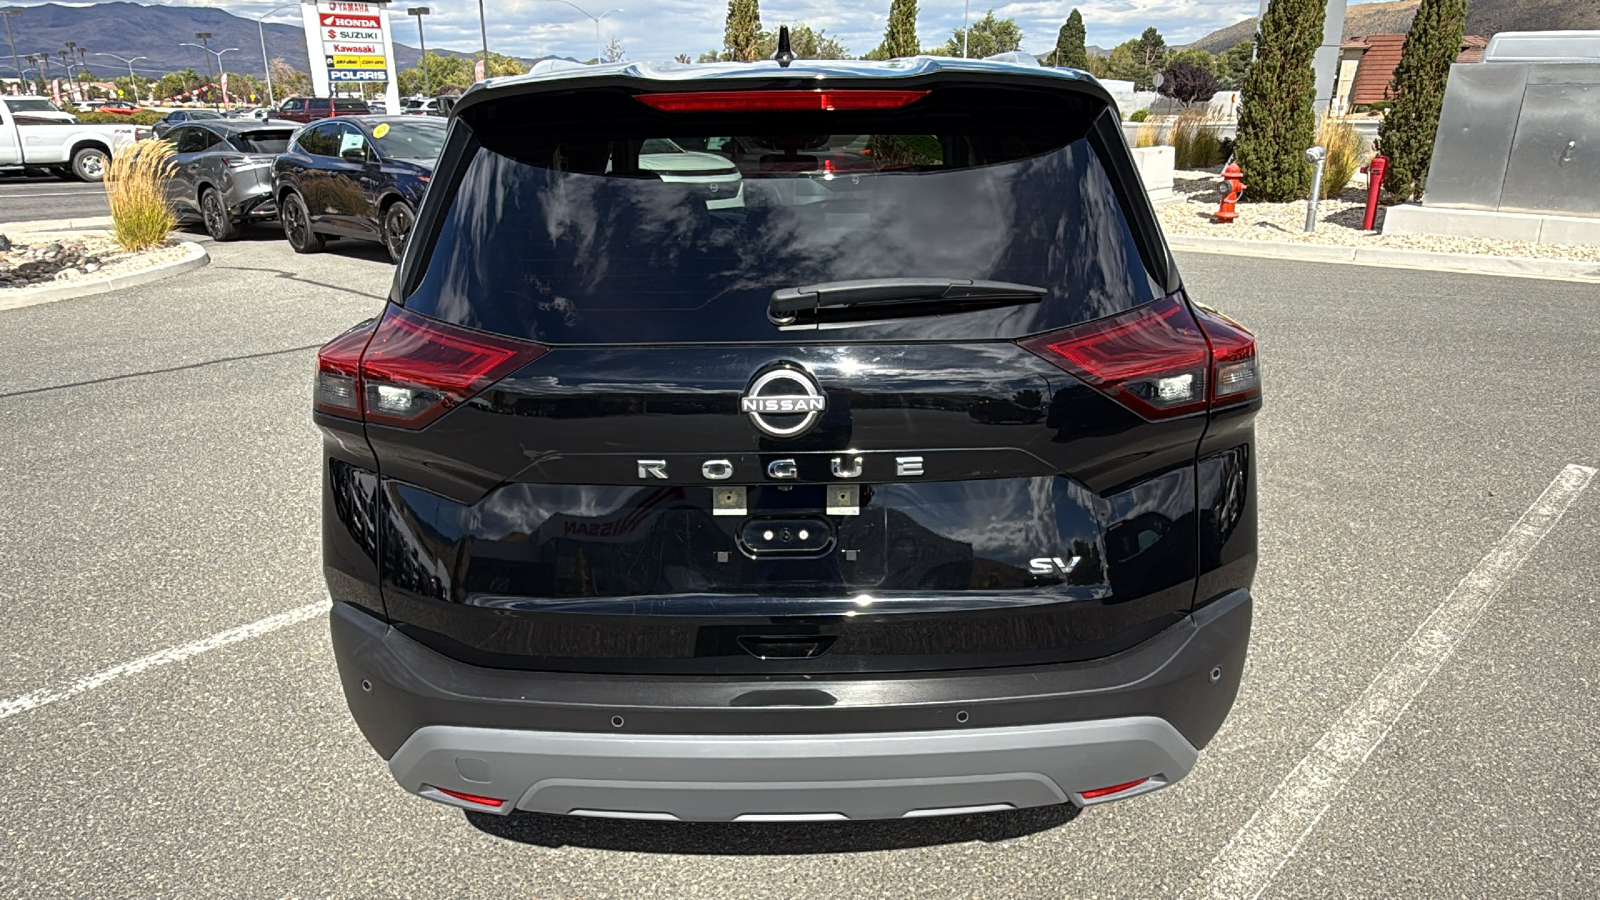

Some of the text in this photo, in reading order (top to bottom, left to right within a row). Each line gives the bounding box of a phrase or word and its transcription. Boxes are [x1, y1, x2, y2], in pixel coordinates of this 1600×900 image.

[337, 2, 369, 12] YAMAHA
[334, 18, 378, 28] HONDA
[339, 31, 378, 40] SUZUKI
[333, 44, 375, 53] Kawasaki
[330, 71, 386, 80] POLARIS
[743, 398, 824, 411] NISSAN
[636, 456, 925, 479] ROGUE
[1029, 555, 1082, 575] SV
